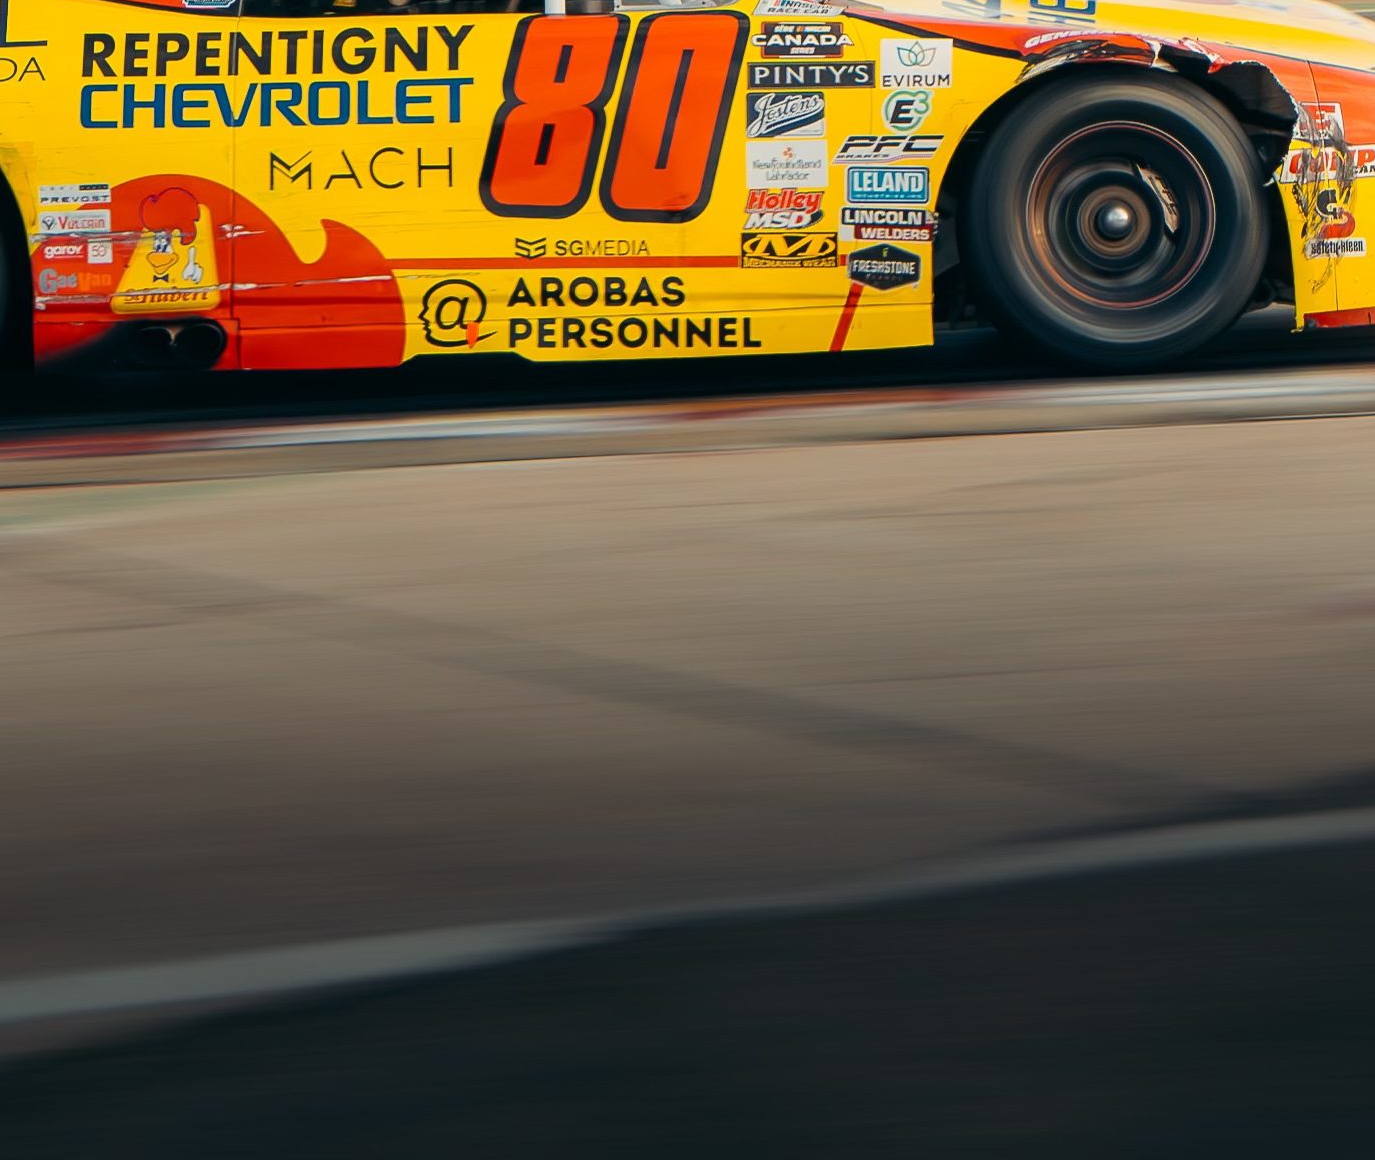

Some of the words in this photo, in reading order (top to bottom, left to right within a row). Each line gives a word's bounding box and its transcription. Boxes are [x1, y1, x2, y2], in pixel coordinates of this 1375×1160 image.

[751, 34, 854, 46] CANADA
[82, 25, 475, 77] REPENTIGNY
[754, 65, 869, 84] PINTY'S
[882, 74, 950, 87] EVIRUM
[80, 77, 474, 128] CHEVROLET
[479, 10, 750, 223] 80
[840, 135, 945, 153] PFC
[270, 147, 453, 190] MACH
[853, 172, 924, 192] LELAND
[40, 195, 109, 203] PREVOST
[746, 188, 824, 214] Holley
[743, 211, 812, 230] MSD
[844, 210, 922, 225] LINCOLN
[861, 227, 930, 240] WELDERS
[507, 276, 686, 307] AROBAS
[509, 317, 761, 348] PERSONNEL
